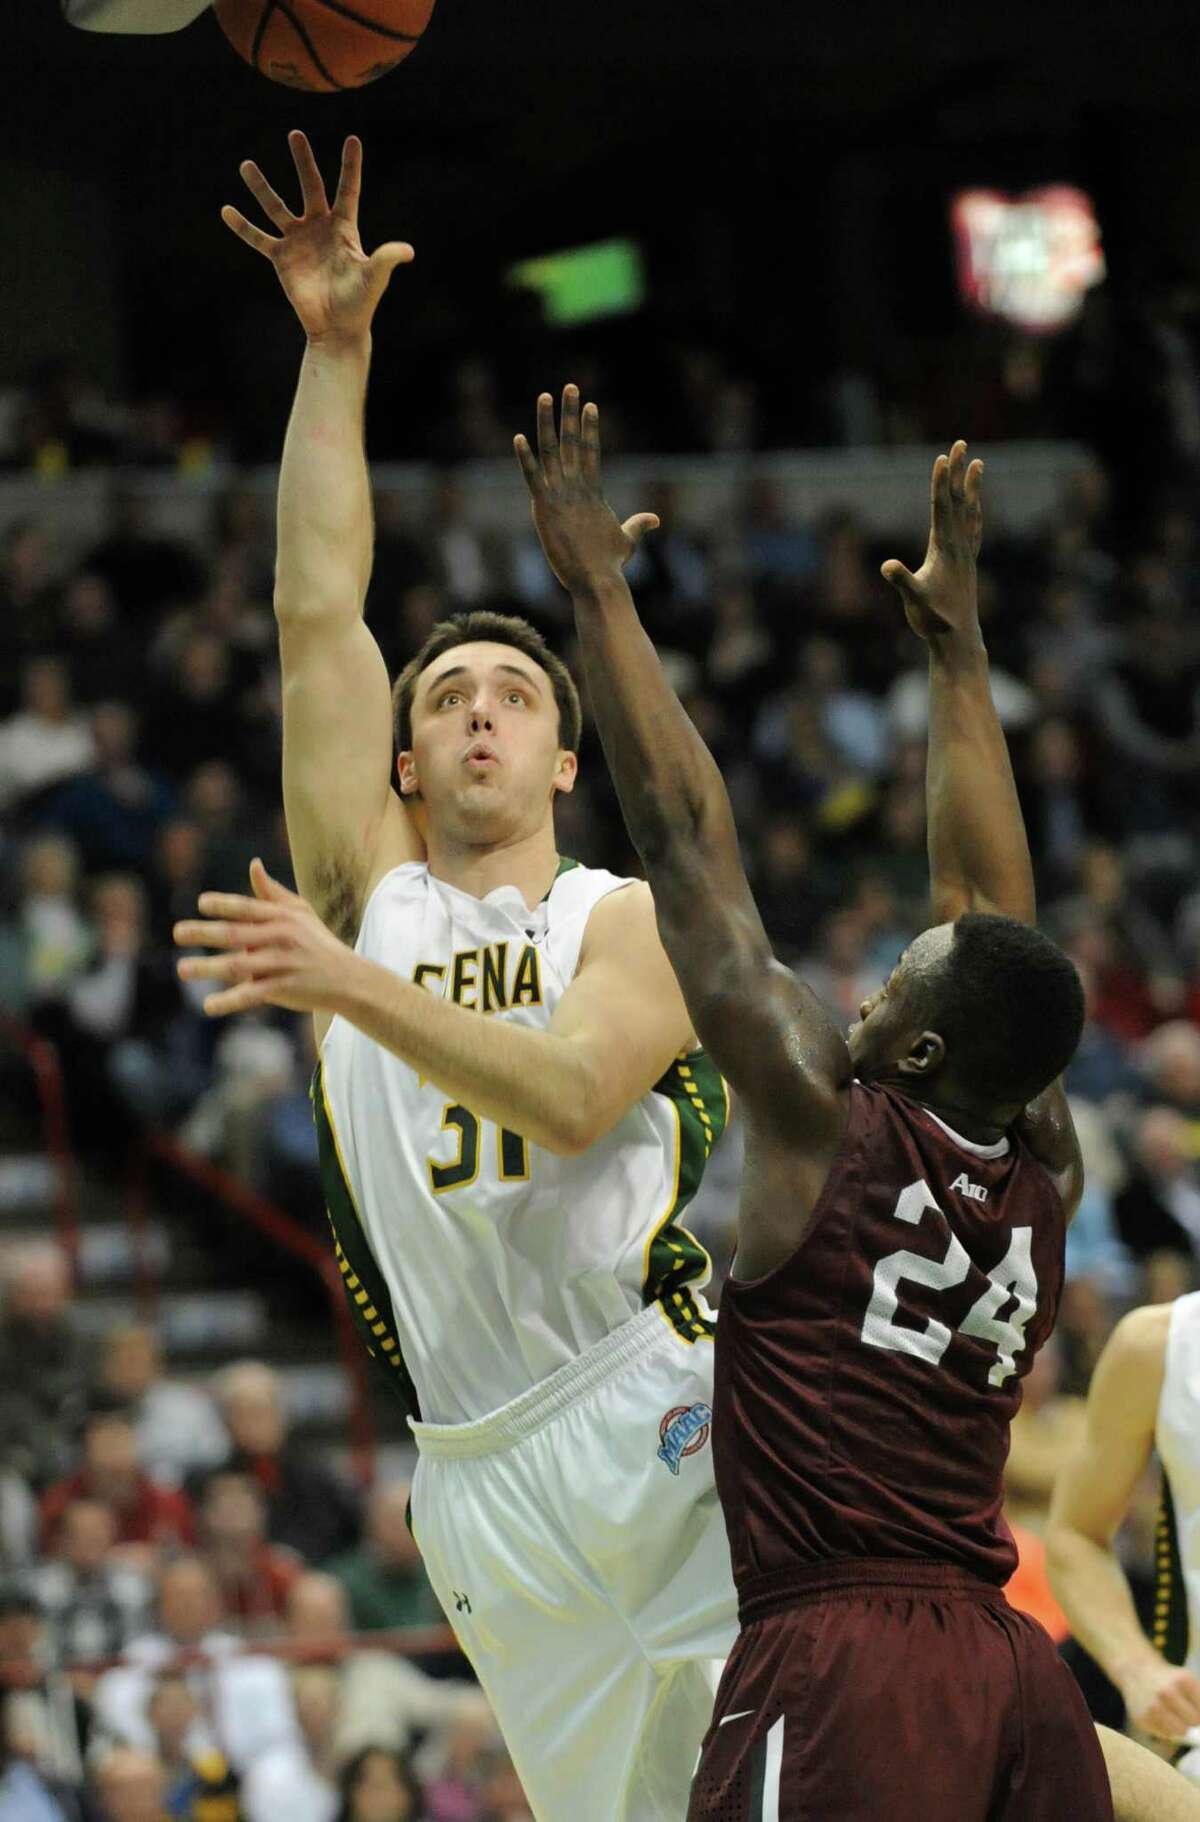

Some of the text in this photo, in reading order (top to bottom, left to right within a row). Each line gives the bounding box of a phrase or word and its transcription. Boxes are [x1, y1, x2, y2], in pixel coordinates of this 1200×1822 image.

[413, 941, 543, 1013] ENA
[861, 1179, 1038, 1388] 24
[657, 1403, 712, 1475] MAAC
